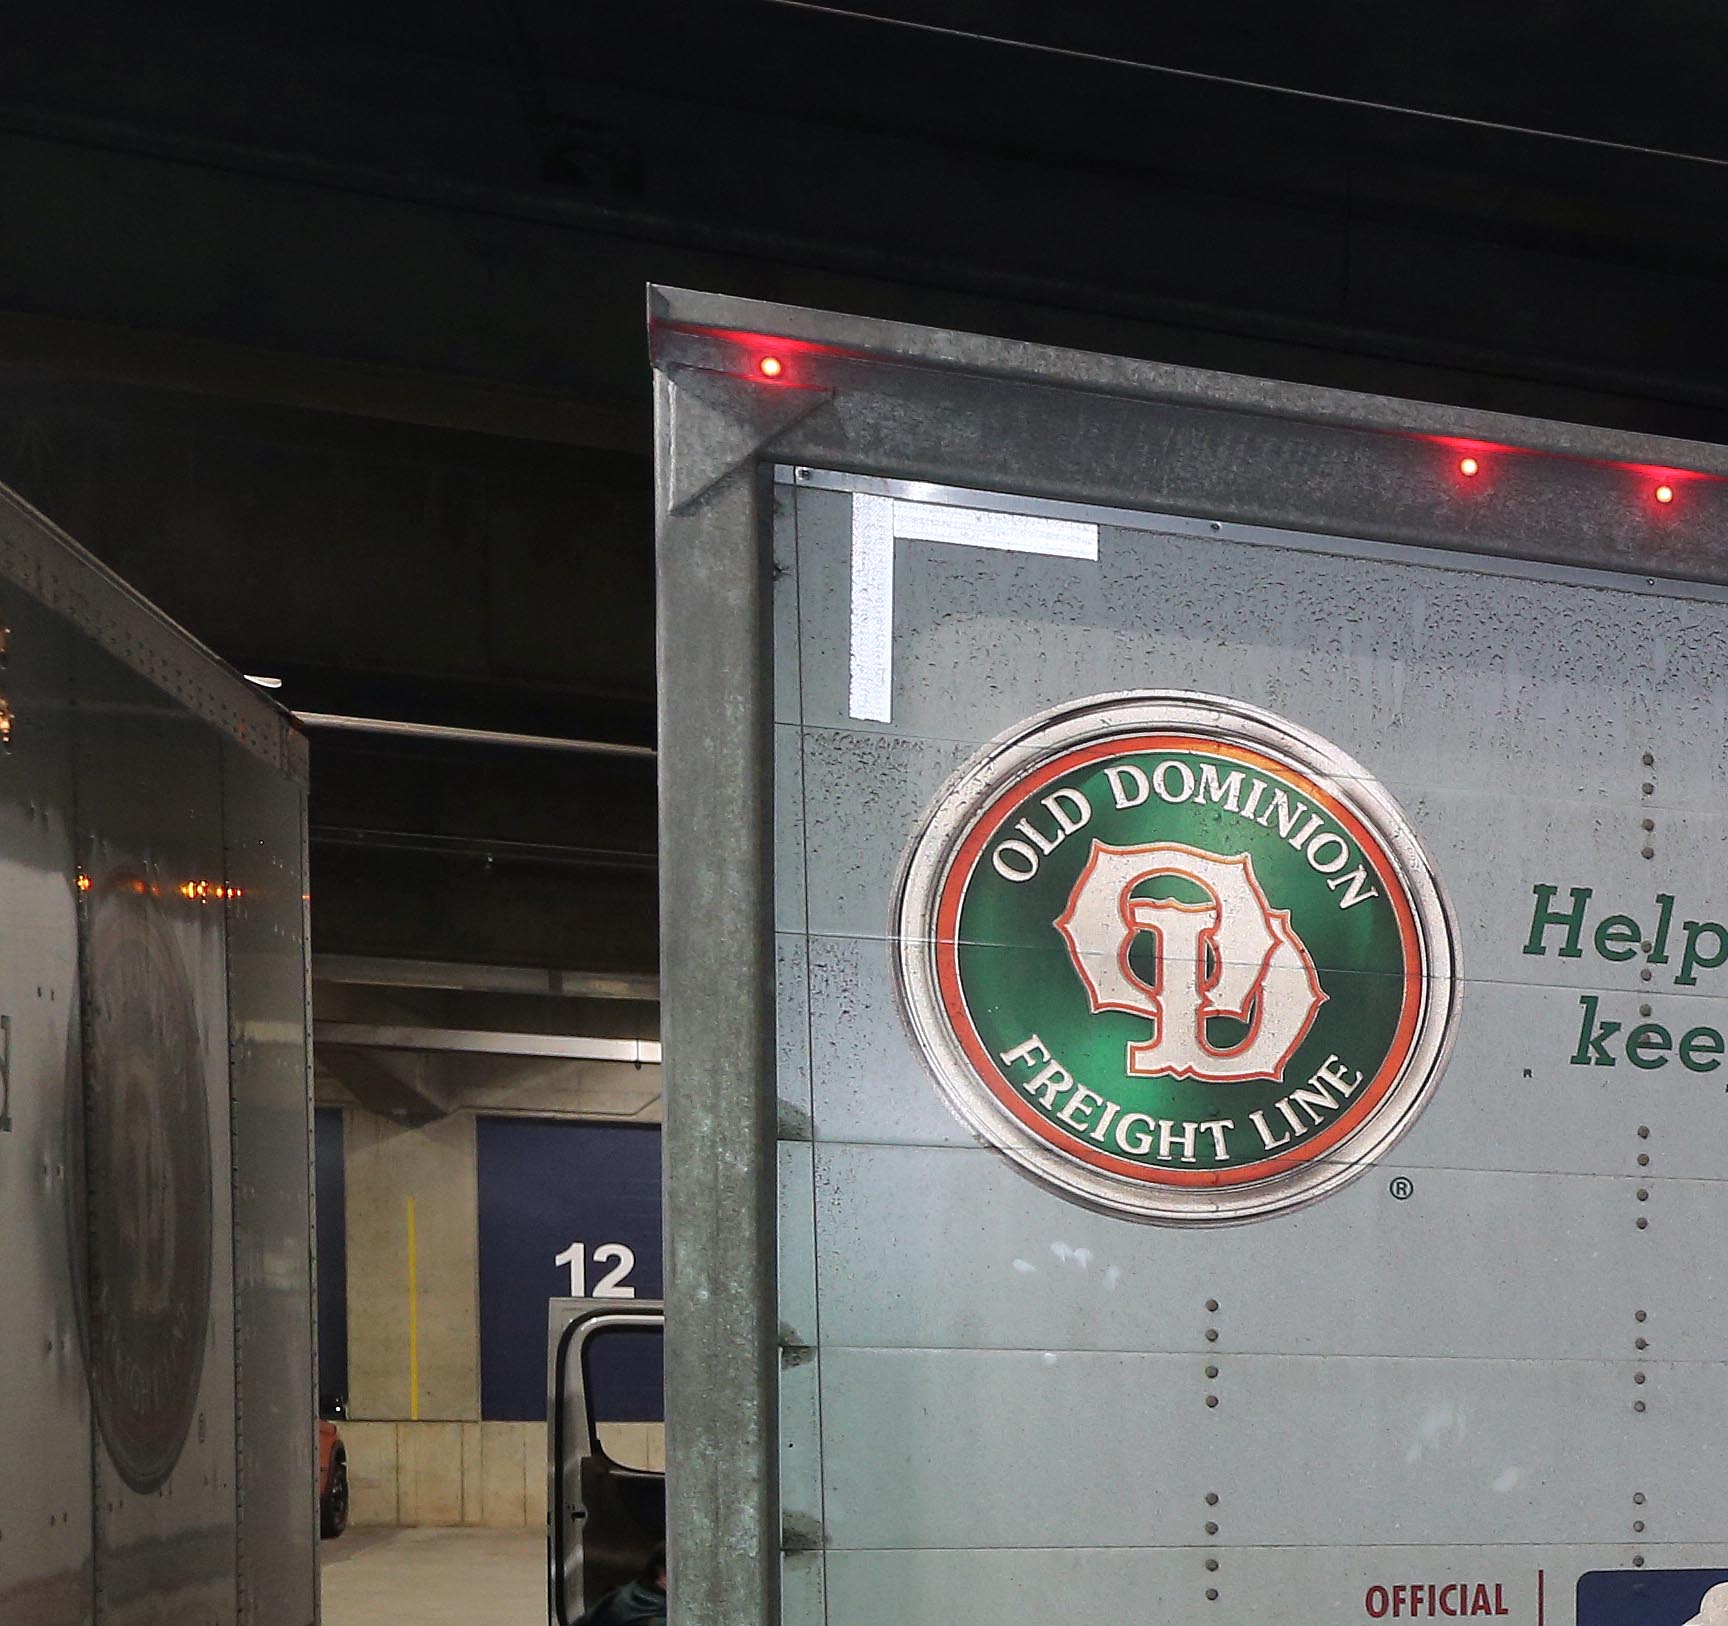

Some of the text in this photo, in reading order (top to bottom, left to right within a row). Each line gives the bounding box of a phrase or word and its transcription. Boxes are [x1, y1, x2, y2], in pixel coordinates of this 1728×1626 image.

[991, 760, 1380, 910] OLD DOMINION
[999, 1033, 1364, 1164] FREIGHT LINE
[555, 1242, 635, 1298] 12
[1365, 1583, 1509, 1618] OFFICIAL
